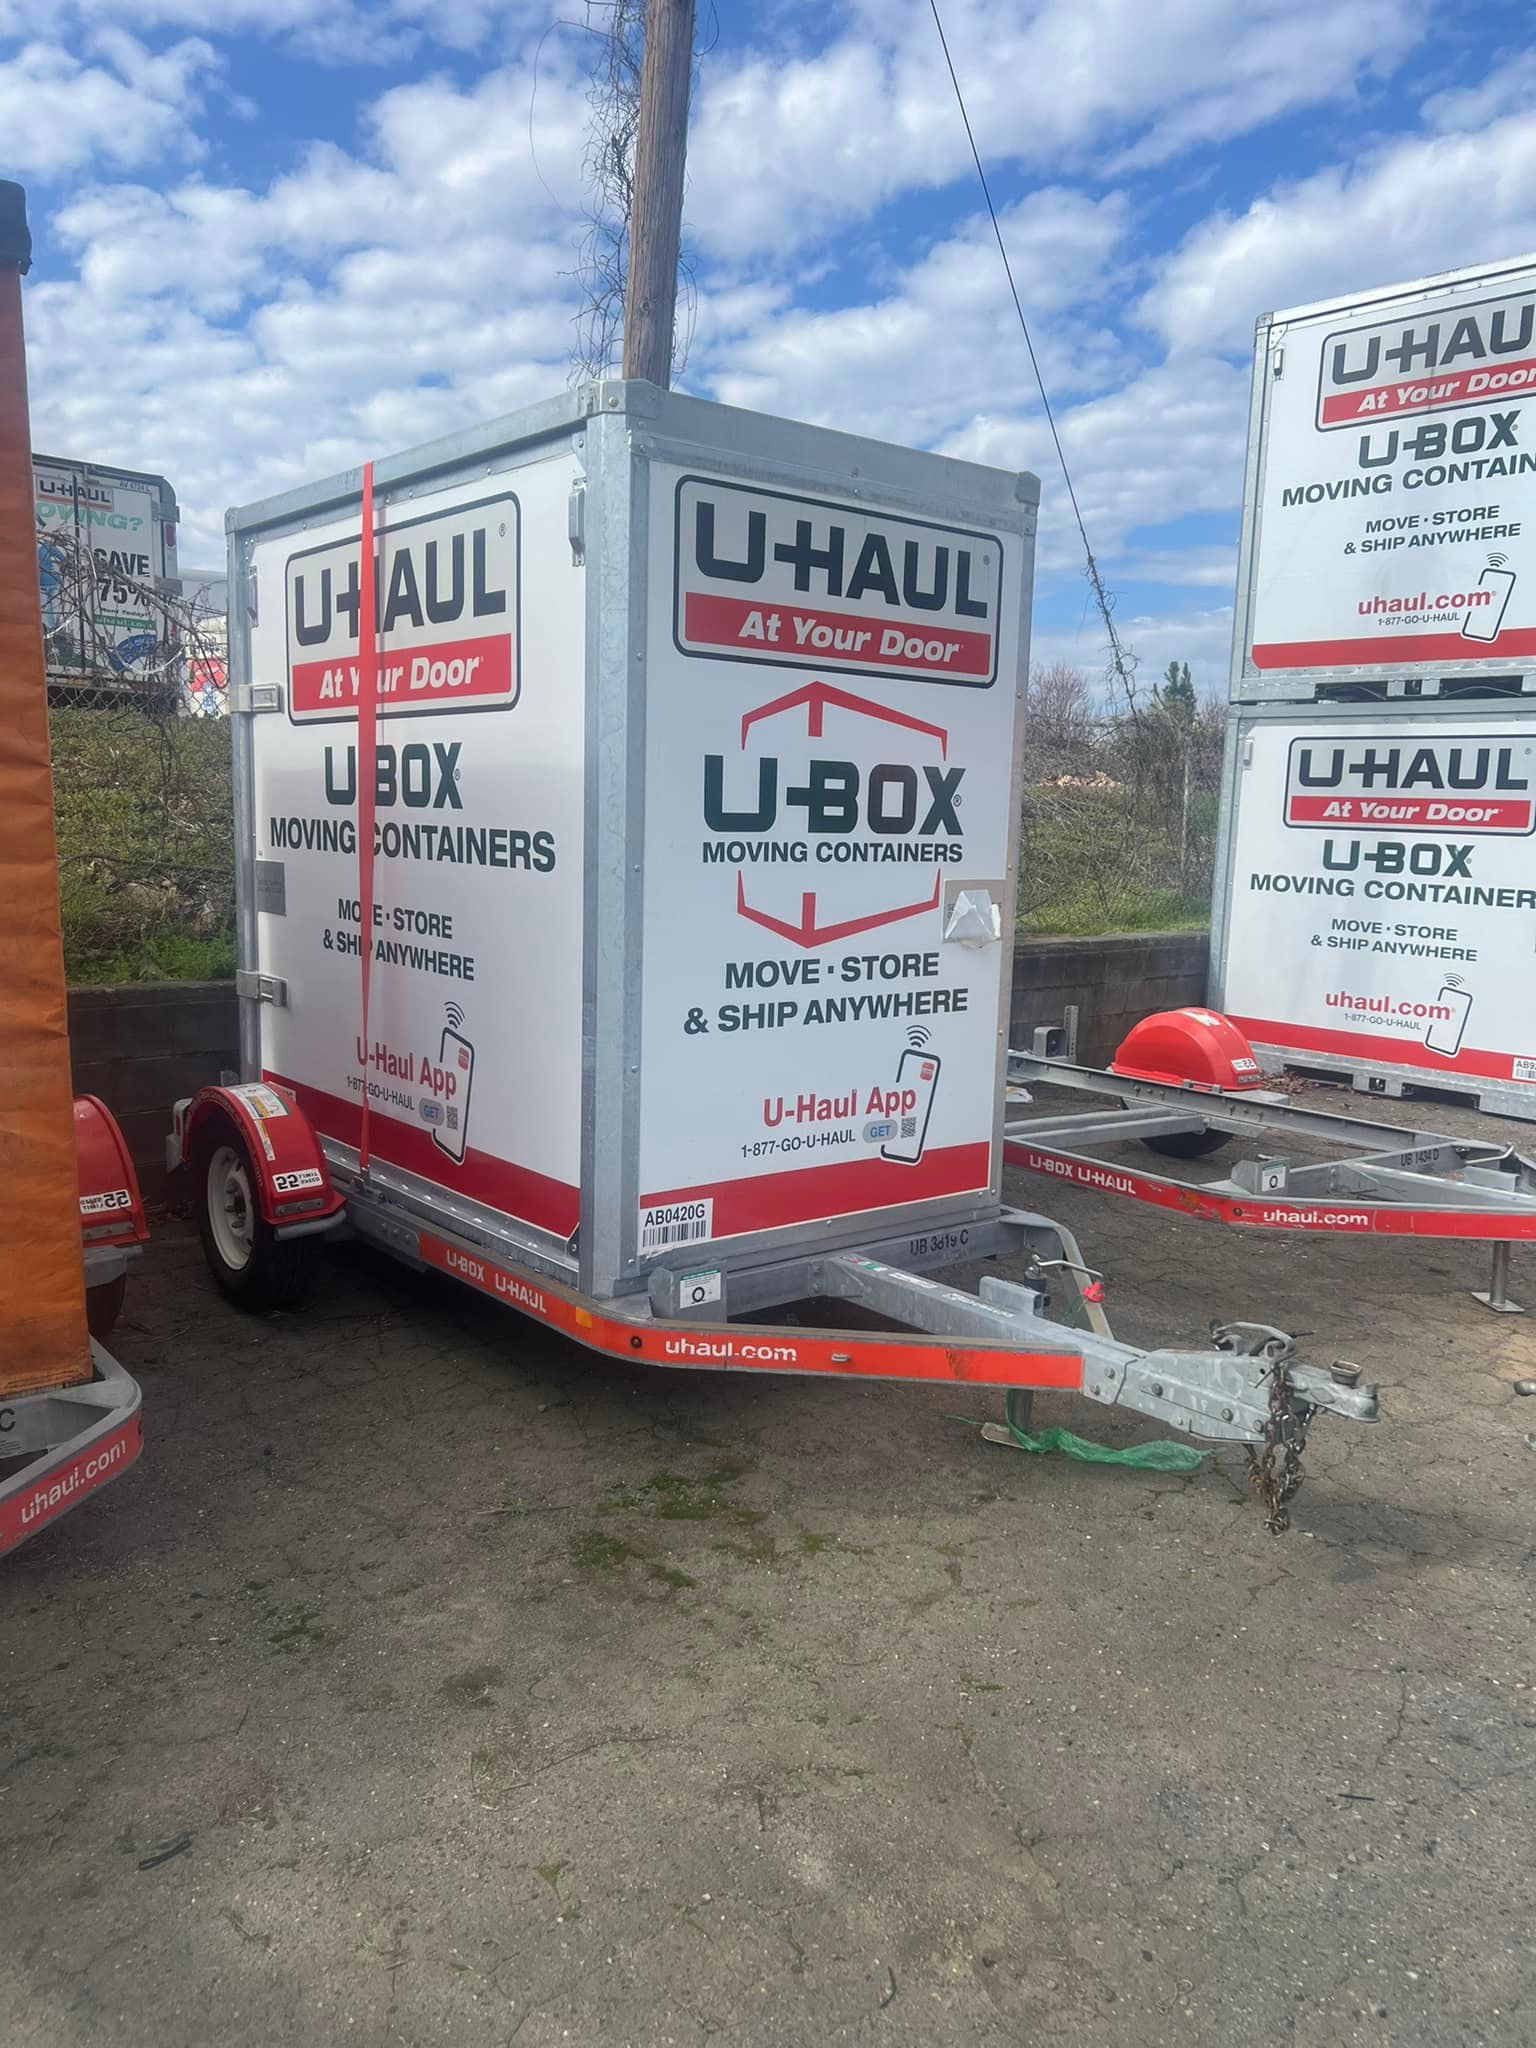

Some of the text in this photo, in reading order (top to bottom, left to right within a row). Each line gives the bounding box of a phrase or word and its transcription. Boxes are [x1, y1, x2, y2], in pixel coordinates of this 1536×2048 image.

[1357, 396, 1388, 413] At
[1397, 379, 1460, 404] Your
[1358, 410, 1521, 468] U-BOX
[40, 479, 111, 503] U-HAUL
[1282, 473, 1392, 507] MOVING
[36, 501, 144, 531] OVING?
[1365, 505, 1500, 534] MOVE STORE
[1343, 522, 1521, 555] & SHIP ANYWHERE
[94, 547, 150, 578] SAVE
[696, 501, 989, 619] U-HAUL
[1357, 590, 1492, 616] uhaul.com
[1377, 611, 1461, 627] 1-877-GO-U-HAUL
[739, 610, 960, 663] At Your Door
[319, 655, 479, 699] At Yur Door
[325, 742, 463, 810] UBOX
[1299, 748, 1528, 791] U-HAUL
[704, 754, 967, 836] U-BOX
[1322, 801, 1499, 822] At Your Door
[270, 817, 556, 872] MOVING CONTAINERS
[702, 841, 963, 864] MOVING CONTAINERS
[1322, 839, 1475, 878] U-BOX
[1250, 873, 1355, 897] MOVING
[338, 898, 453, 940] MOE STORE
[1331, 918, 1458, 941] MOVE STORE
[323, 928, 334, 950] &
[375, 939, 475, 981] ANYWHERE
[1311, 935, 1478, 962] & SHIP ANYWHERE
[725, 952, 940, 990] MOVE STORE
[683, 988, 969, 1035] & SHIP ANYWHERE
[1325, 991, 1452, 1020] uhaul.com
[1344, 1013, 1422, 1030] 1-877-GO-U-HAUL
[356, 1036, 457, 1101] U-Haul App
[763, 1086, 917, 1127] U-Haul App
[741, 1130, 857, 1158] 1-877-GO-U-HAUL
[869, 1125, 893, 1138] GET
[1029, 1154, 1137, 1194] U-BOX U-HAUL
[645, 1203, 705, 1227] AB0420G
[1263, 1210, 1368, 1226] uhaul.com
[910, 1238, 927, 1256] UB
[960, 1229, 969, 1245] C
[446, 1249, 547, 1313] U-BOX U-HAUL
[665, 1339, 797, 1362] uhaul.com
[21, 1440, 126, 1523] uhaul.com
